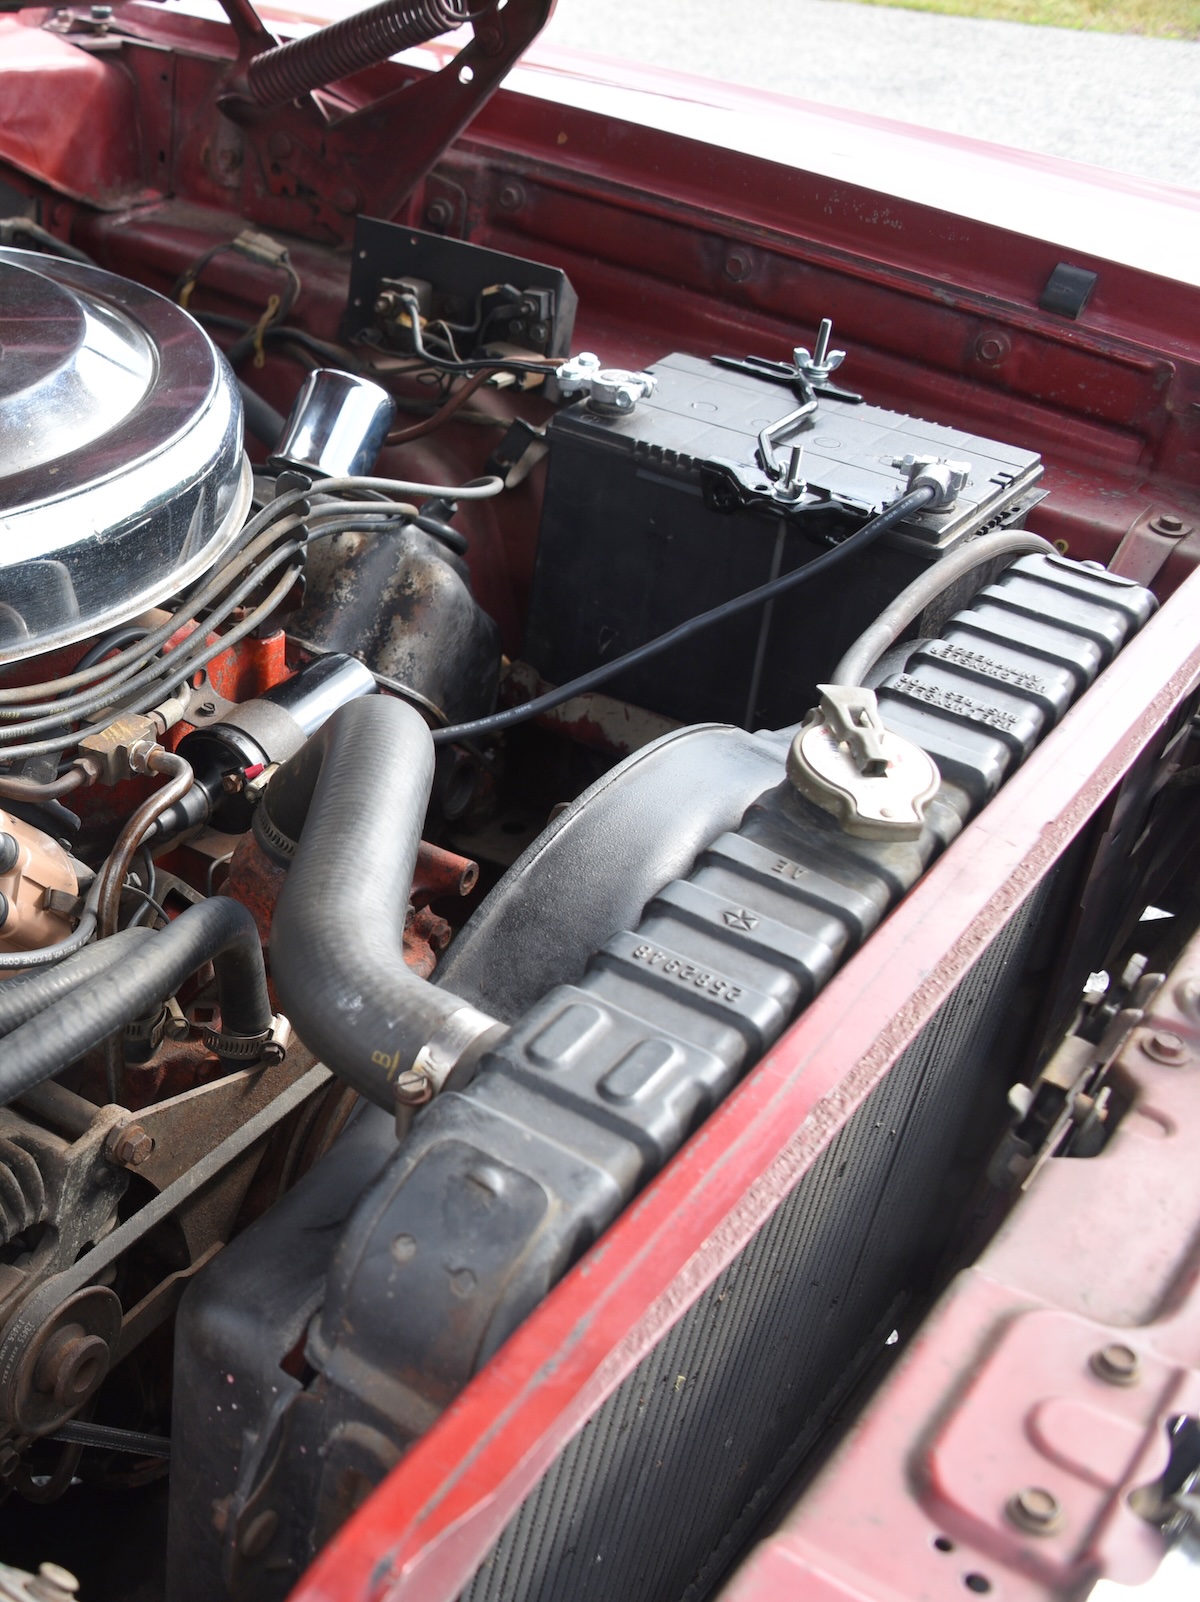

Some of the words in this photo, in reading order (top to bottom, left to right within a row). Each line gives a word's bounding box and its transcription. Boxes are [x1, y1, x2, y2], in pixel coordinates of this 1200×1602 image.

[929, 646, 1008, 680] CHRYSLER
[948, 643, 1044, 682] ANTIFREEZE
[896, 680, 976, 720] CHRYSLER
[900, 675, 973, 706] RESISTOR
[1015, 676, 1047, 693] USE
[980, 704, 1018, 723] RUST
[981, 713, 1014, 731] USE
[632, 944, 745, 1002] 2582948
